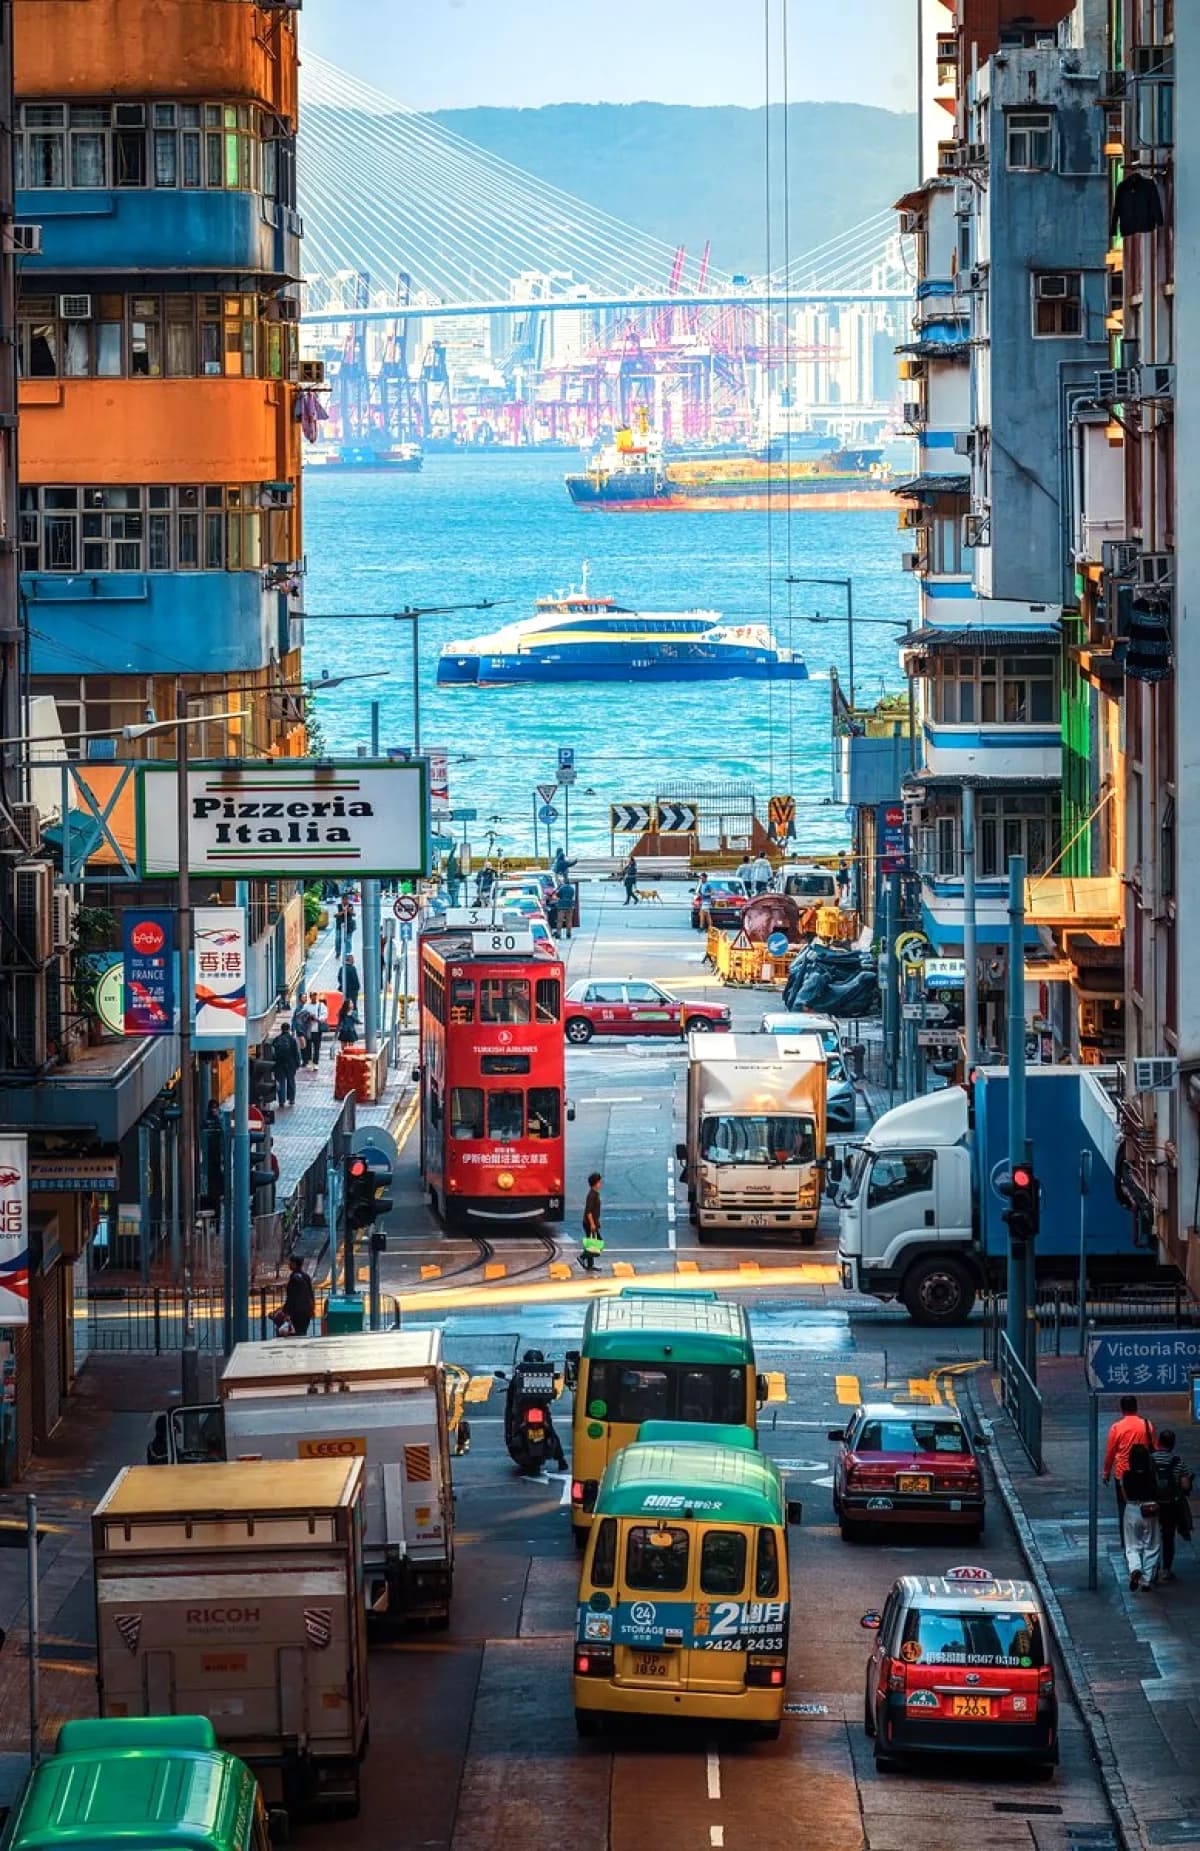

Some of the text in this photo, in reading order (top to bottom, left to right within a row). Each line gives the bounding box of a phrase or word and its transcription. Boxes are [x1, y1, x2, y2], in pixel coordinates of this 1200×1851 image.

[193, 796, 374, 818] Pizzeria
[216, 822, 350, 843] Italia
[469, 911, 478, 924] 3
[491, 936, 515, 950] 80
[199, 952, 241, 971] 香港
[132, 970, 164, 980] FRANCE
[452, 968, 463, 977] 80
[550, 968, 560, 977] 80
[472, 1045, 537, 1053] TURKISH AIRLINES
[1107, 1342, 1171, 1357] Victoria
[643, 1495, 685, 1508] AMS
[953, 1568, 987, 1579] TAXI
[186, 1608, 260, 1623] RICOH
[636, 1606, 651, 1619] 24
[621, 1625, 664, 1635] STORAGE
[705, 1638, 783, 1652] 2424 2433
[956, 1705, 988, 1716] 7203
